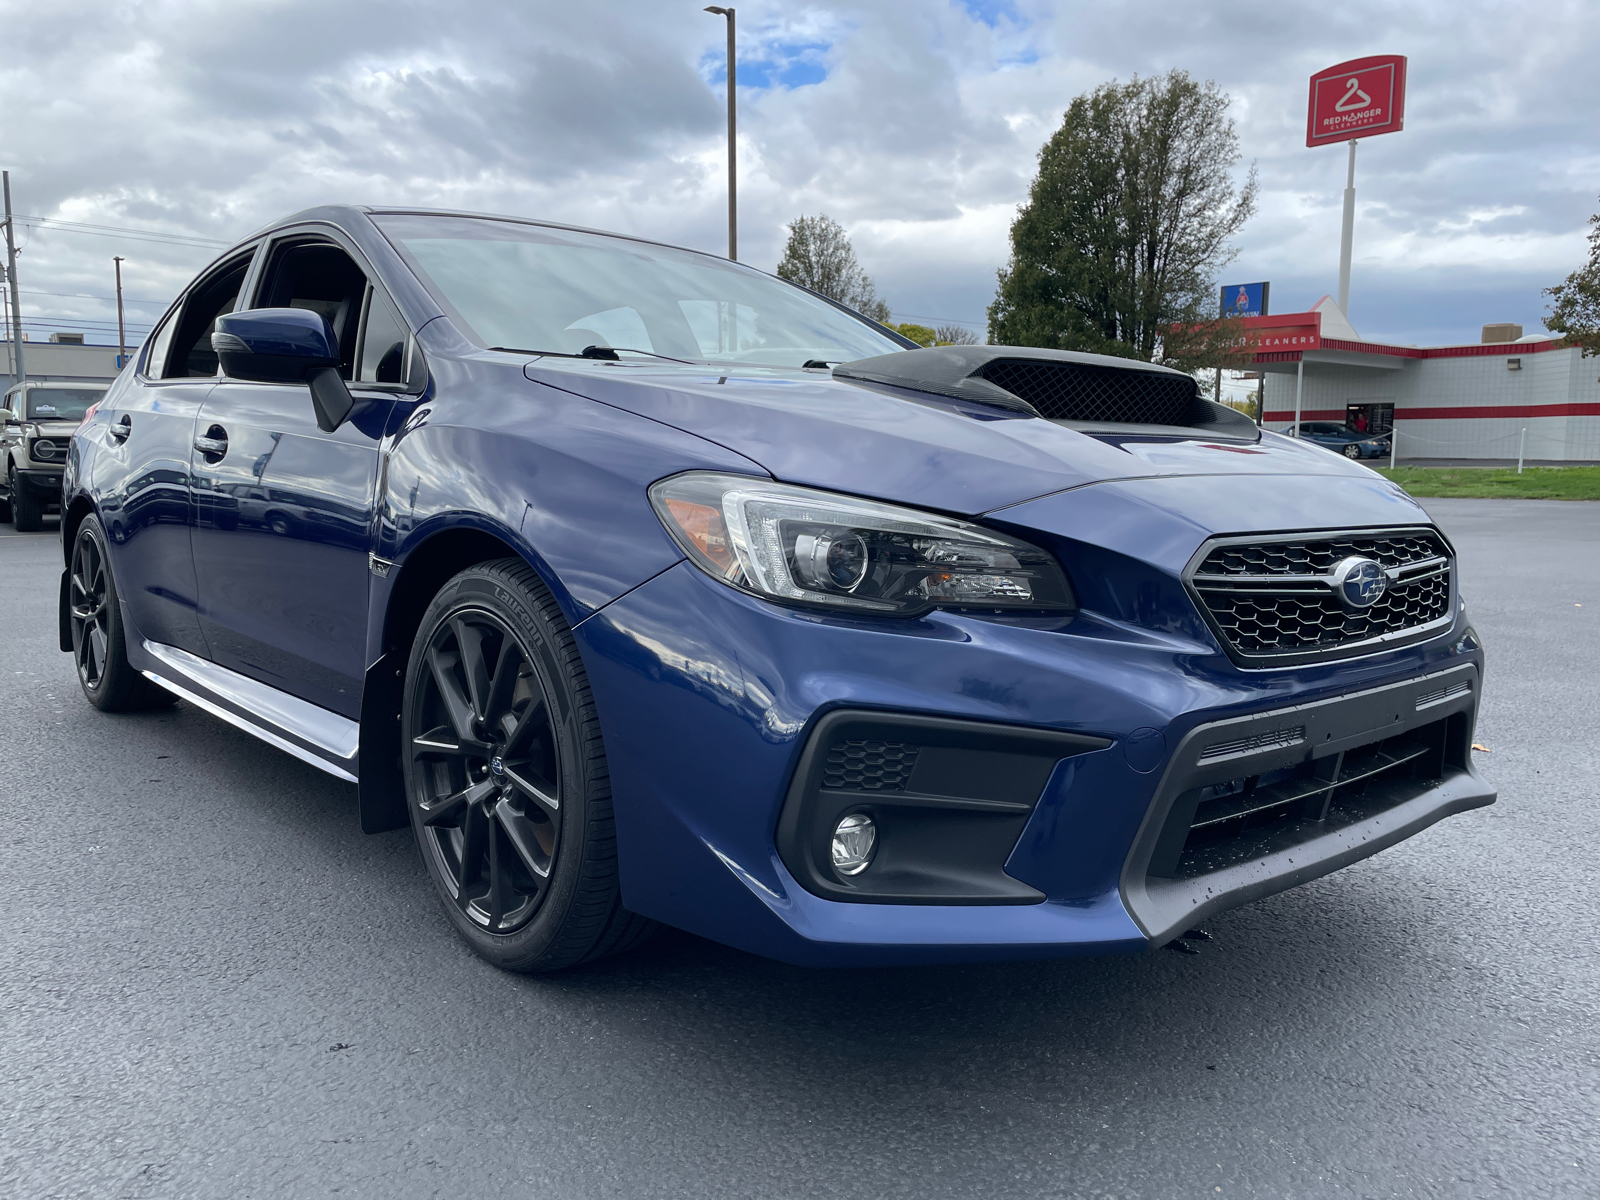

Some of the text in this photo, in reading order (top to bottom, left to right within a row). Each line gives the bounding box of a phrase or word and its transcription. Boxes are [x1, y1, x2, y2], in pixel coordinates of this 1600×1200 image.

[1323, 117, 1341, 126] RED
[1330, 118, 1373, 130] CLEANERS
[1250, 336, 1315, 346] CLEANERS
